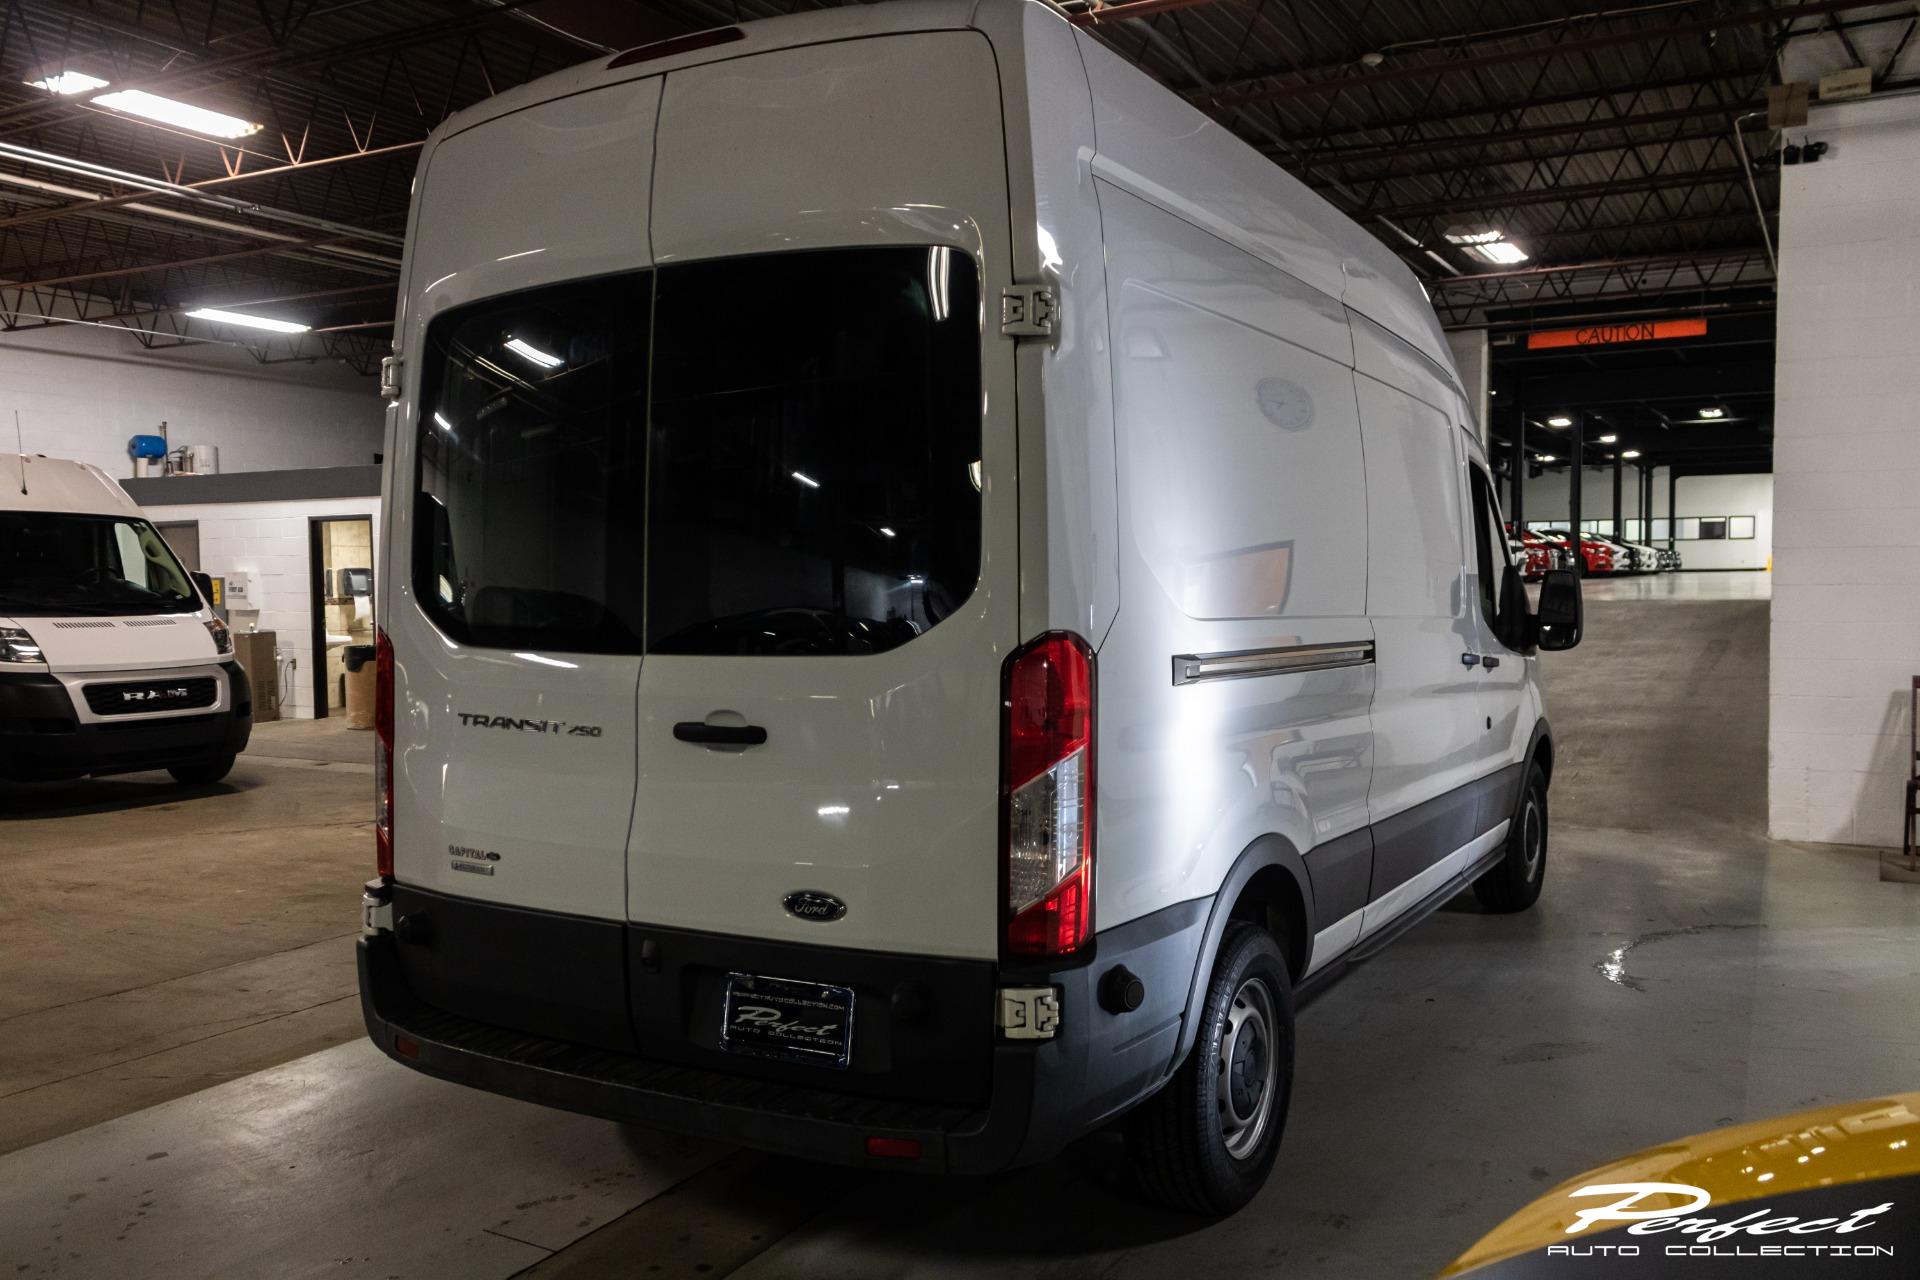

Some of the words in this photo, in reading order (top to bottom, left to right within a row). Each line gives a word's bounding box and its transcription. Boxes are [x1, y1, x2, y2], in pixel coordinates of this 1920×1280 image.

[1576, 323, 1655, 344] CAUTION
[122, 688, 188, 701] RAM
[458, 712, 565, 735] TRANSIT
[567, 725, 602, 738] 250
[448, 844, 488, 861] CAPITAL
[794, 896, 830, 915] Ford
[729, 1025, 761, 1034] AUTO
[734, 1005, 839, 1036] Perfect
